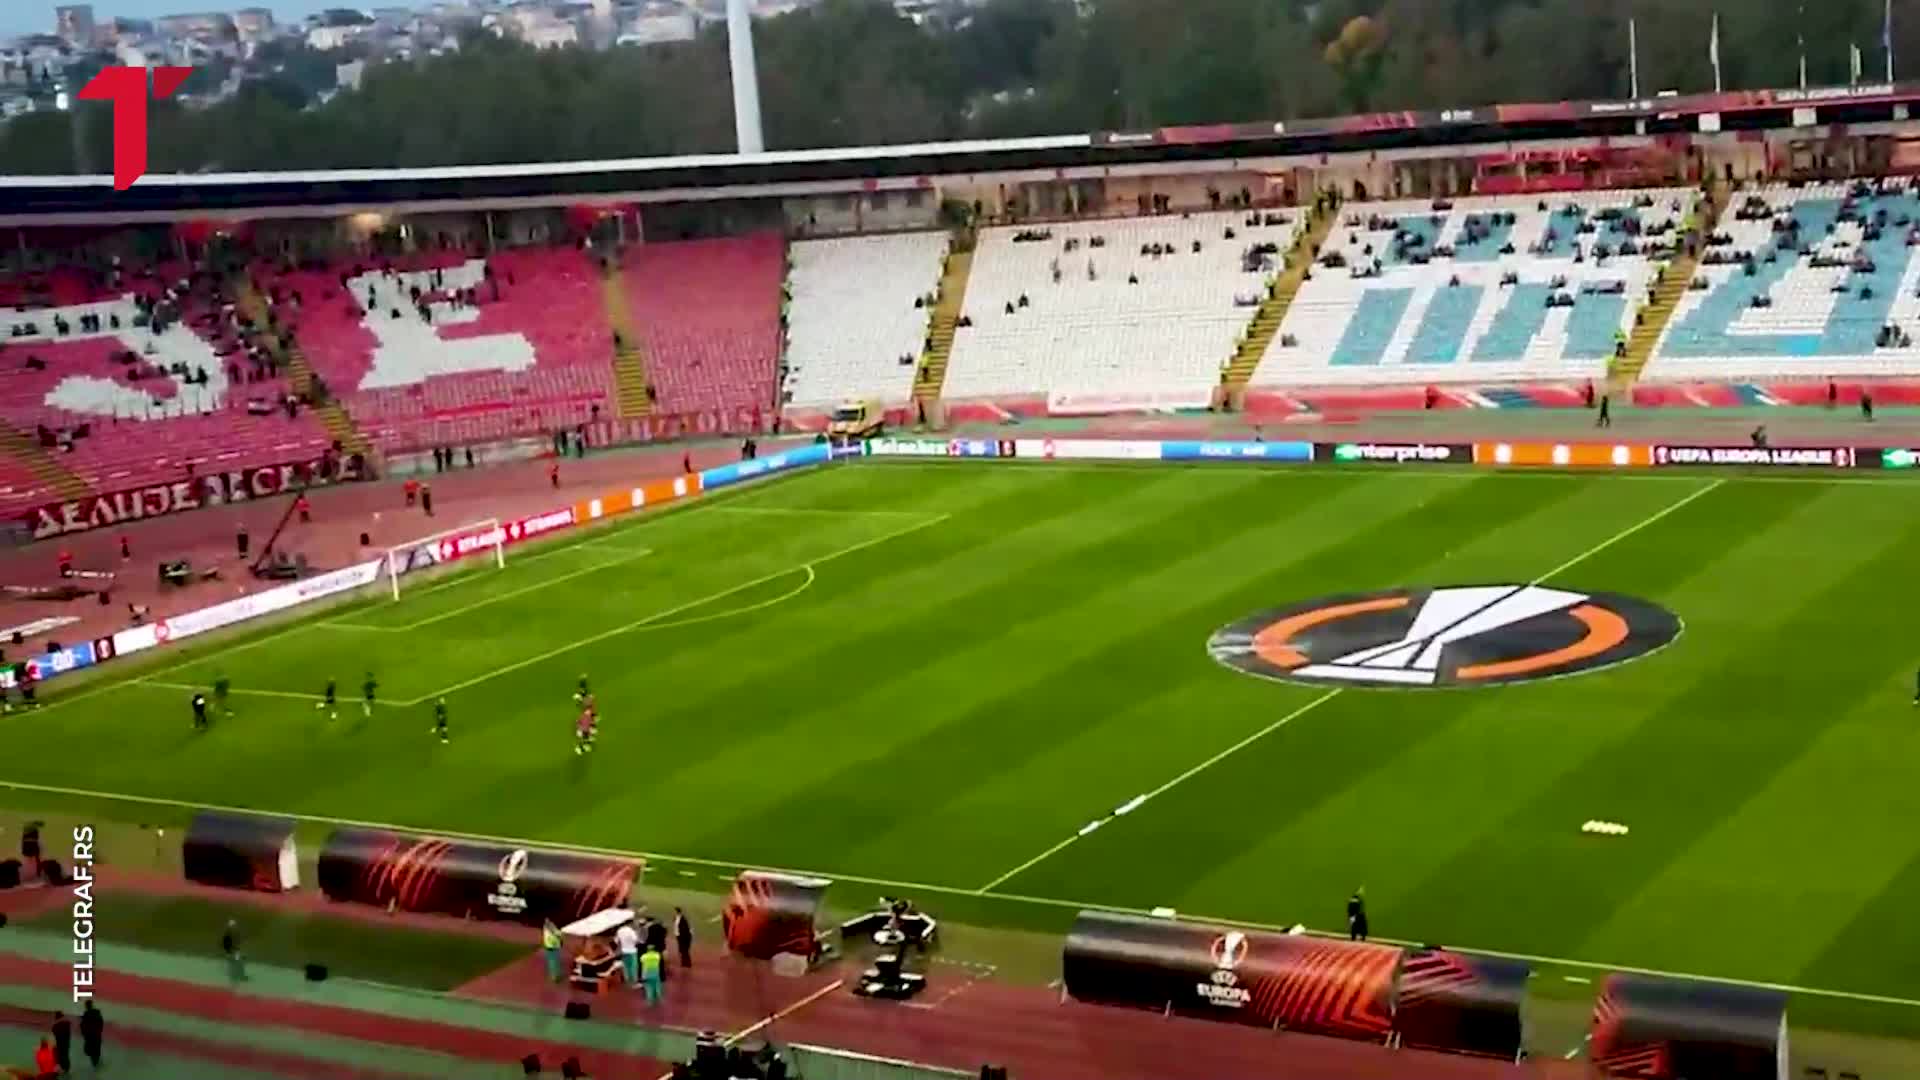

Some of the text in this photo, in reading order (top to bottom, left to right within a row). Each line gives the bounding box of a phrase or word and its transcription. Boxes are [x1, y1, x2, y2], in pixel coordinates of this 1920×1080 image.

[1670, 448, 1832, 464] UEFA EUROPA LEAGUE
[1196, 982, 1252, 1002] EUROPA
